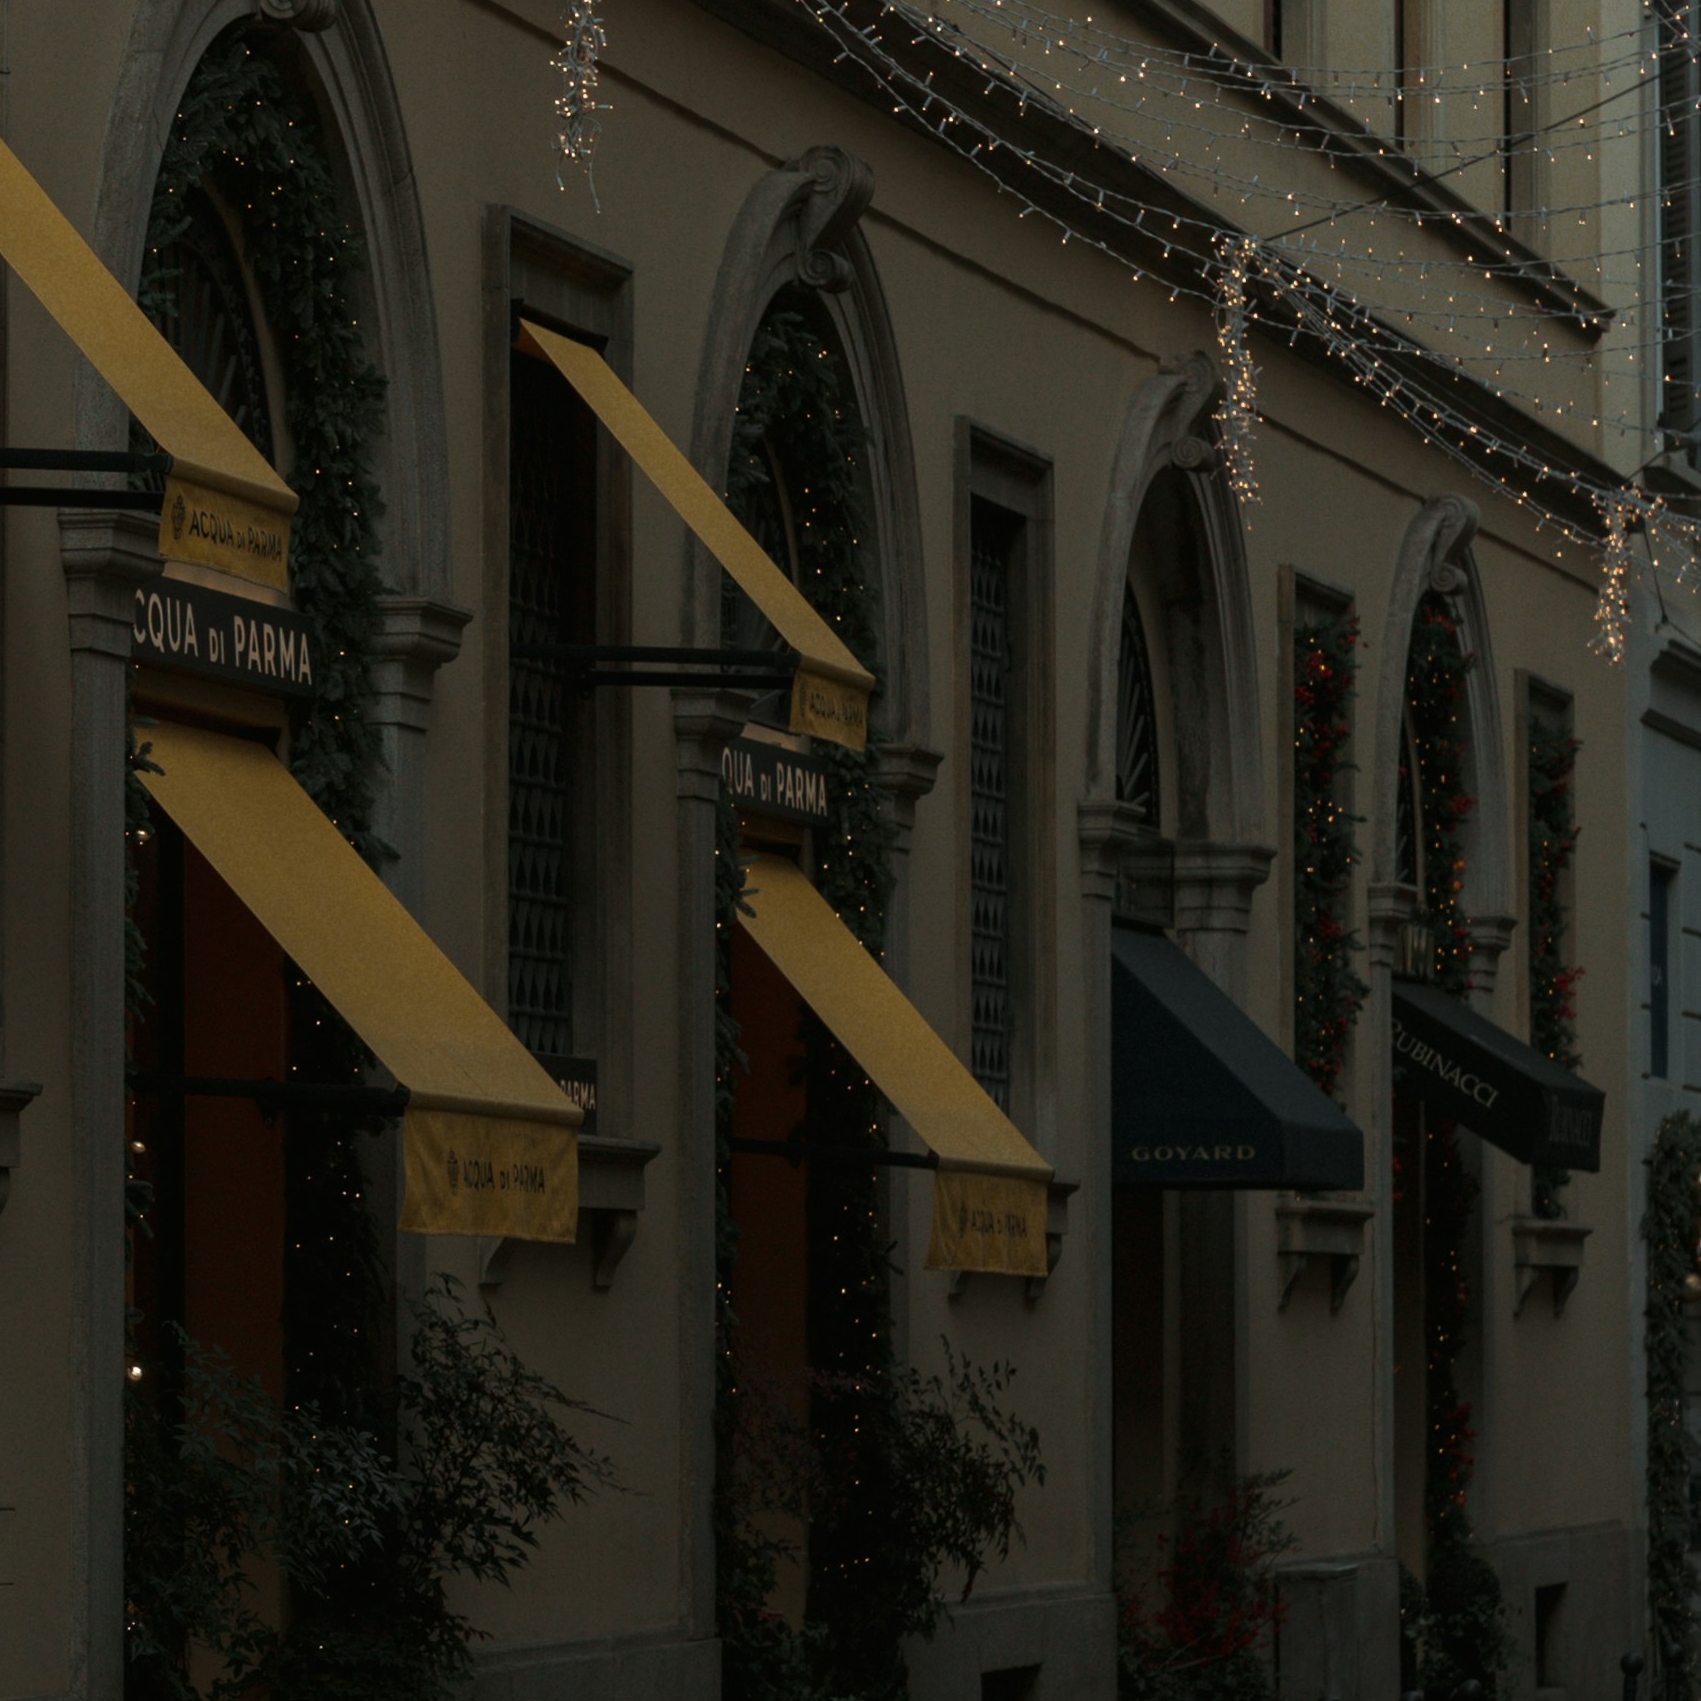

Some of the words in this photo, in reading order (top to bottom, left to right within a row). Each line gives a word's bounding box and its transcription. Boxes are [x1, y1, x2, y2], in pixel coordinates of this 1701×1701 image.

[189, 508, 235, 546] ACQUA
[233, 614, 313, 686] PARMA
[776, 761, 828, 817] PARMA
[1131, 1144, 1257, 1162] GOYARD
[513, 1163, 545, 1194] PARMA
